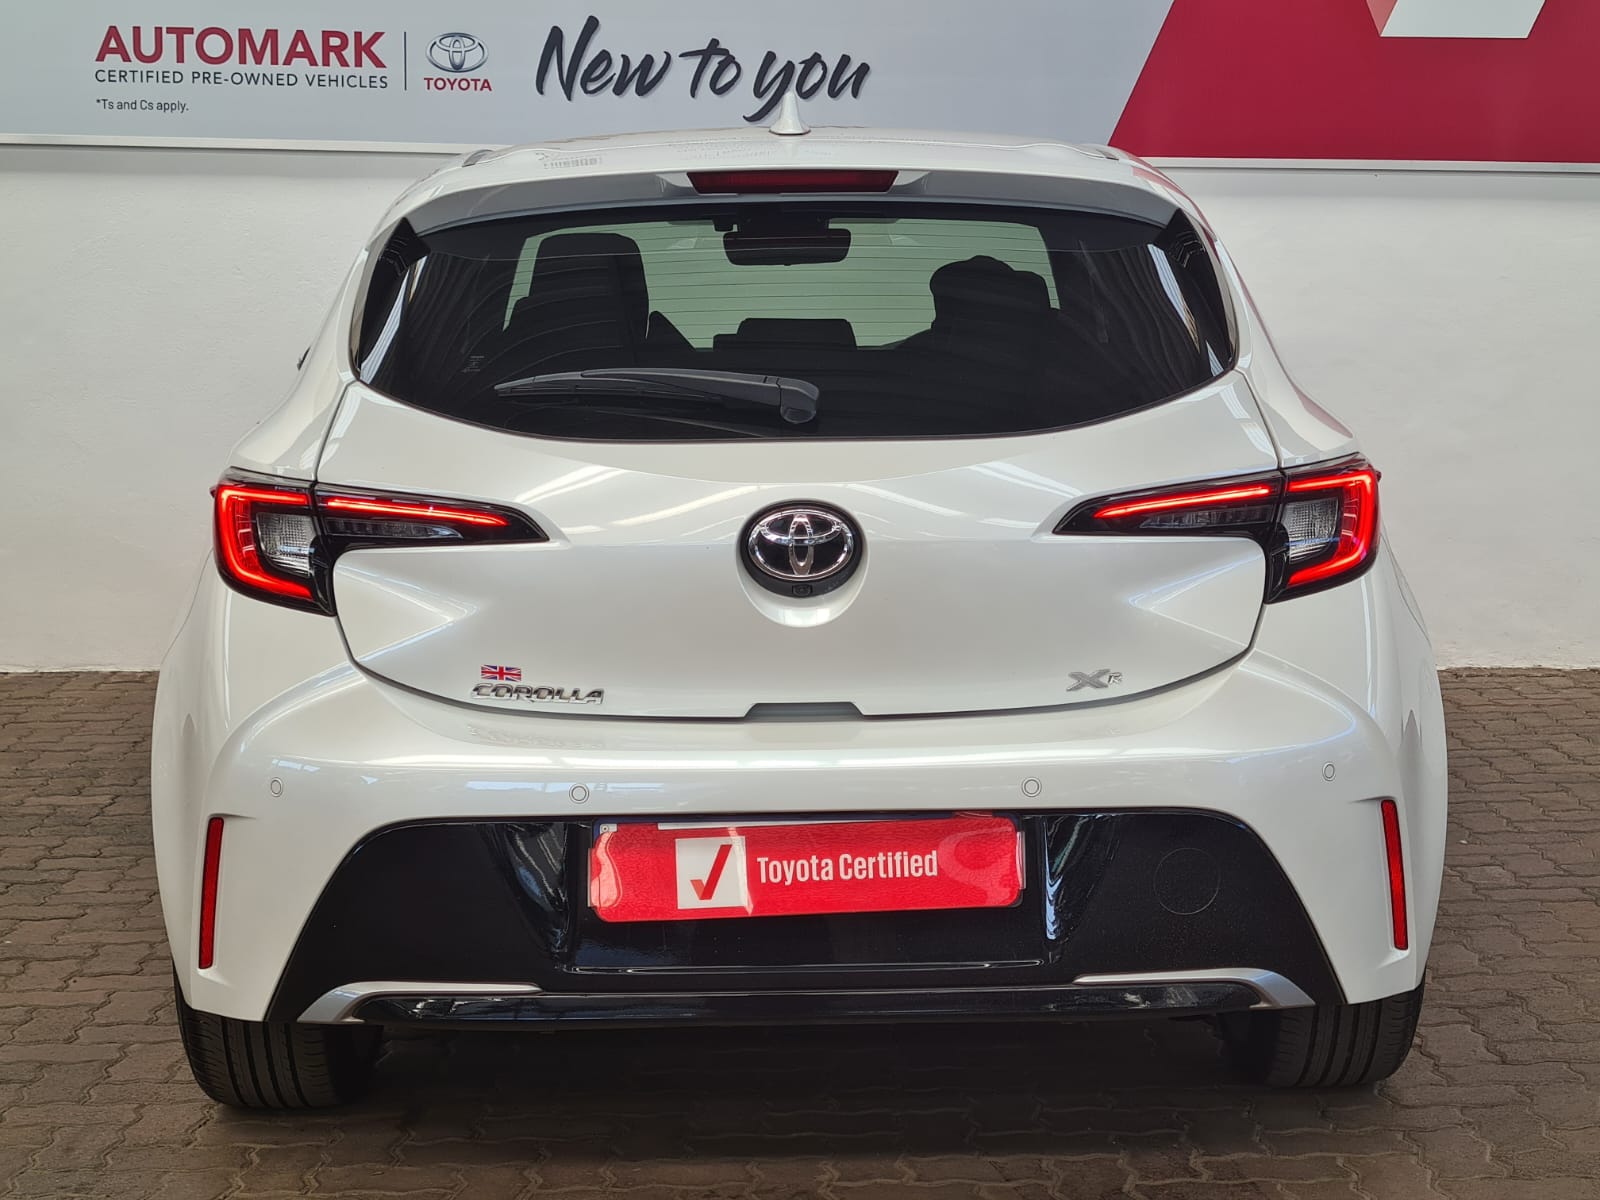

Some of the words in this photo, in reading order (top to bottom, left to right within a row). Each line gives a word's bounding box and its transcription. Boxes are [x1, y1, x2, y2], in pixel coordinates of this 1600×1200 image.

[95, 25, 387, 68] AUTOMARK
[95, 69, 184, 84] CERTIFIED
[192, 71, 298, 87] PRE-OWNED
[305, 74, 388, 88] VEHICLES
[536, 15, 671, 101] New
[679, 38, 742, 99] to
[742, 50, 871, 122] you
[424, 77, 492, 92] TOYOTA
[116, 100, 137, 110] and
[140, 99, 154, 110] Cs
[156, 100, 189, 113] apply.
[471, 682, 604, 705] COROLLA
[756, 855, 834, 886] Toyota
[838, 850, 938, 881] Certified
